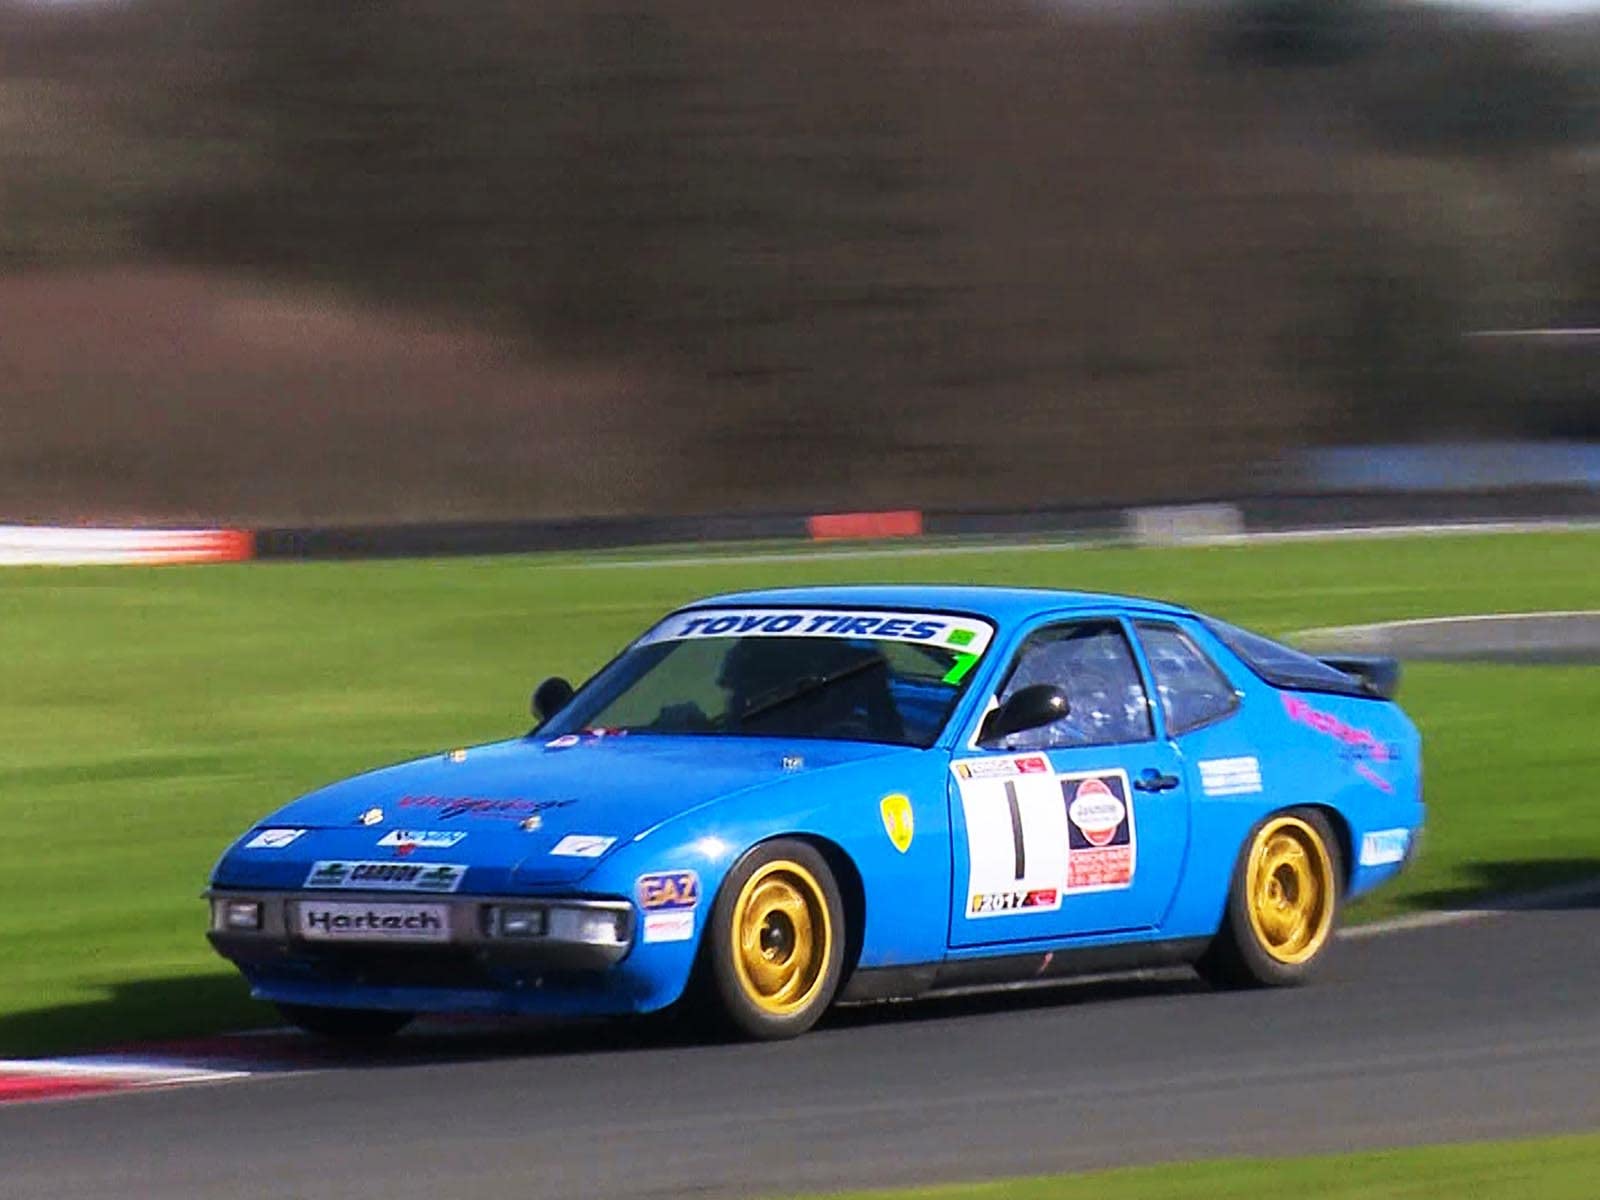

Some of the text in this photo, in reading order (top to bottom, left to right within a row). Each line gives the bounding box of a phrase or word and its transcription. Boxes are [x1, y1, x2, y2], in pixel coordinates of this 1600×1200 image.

[678, 615, 946, 639] TOYO TIRES
[1004, 780, 1025, 880] 1
[640, 878, 697, 906] GAZ
[979, 892, 1027, 912] 2017
[308, 911, 440, 932] Hartech
